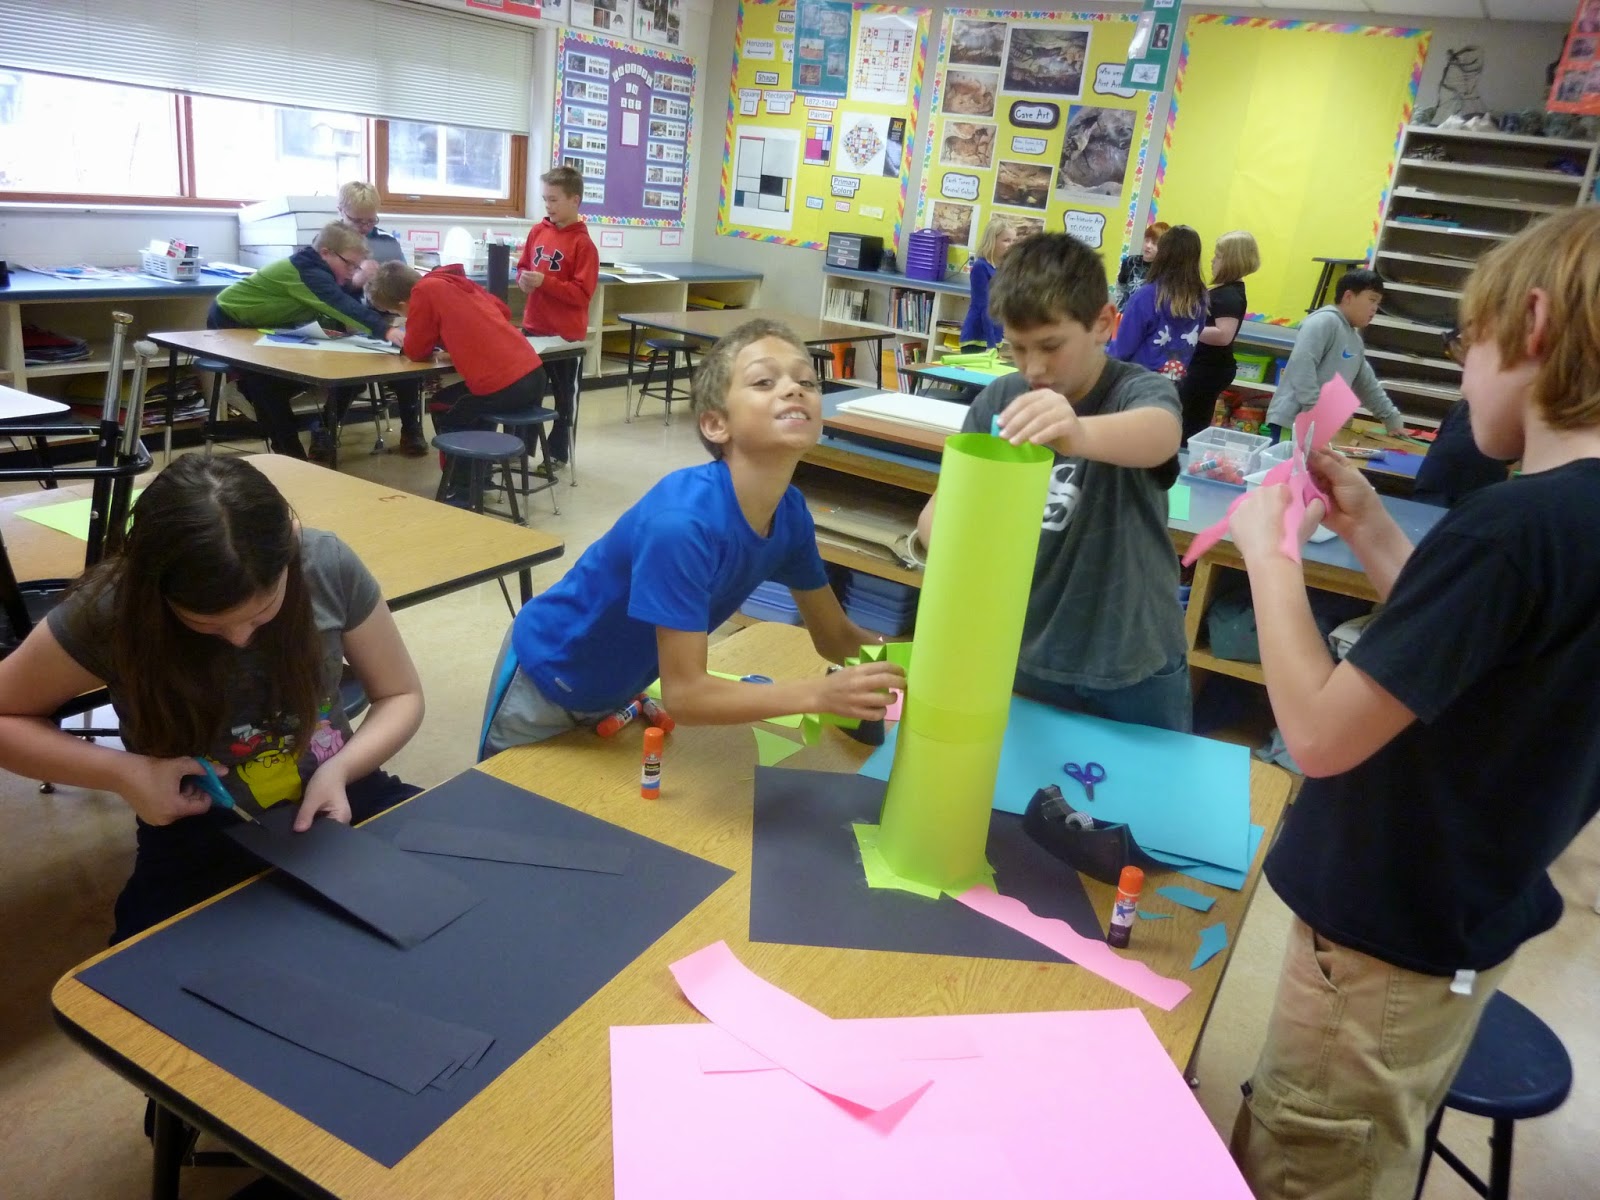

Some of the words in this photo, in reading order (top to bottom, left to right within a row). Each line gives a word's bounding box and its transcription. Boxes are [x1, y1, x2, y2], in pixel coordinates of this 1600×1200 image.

[781, 12, 794, 20] Line
[746, 39, 774, 48] Horizontal
[758, 74, 777, 83] Shape
[740, 90, 760, 98] Square
[765, 91, 793, 100] Rectangle
[806, 98, 836, 107] 1872-1944
[810, 111, 831, 119] Painter
[1016, 109, 1033, 119] Cave
[1036, 109, 1050, 119] Art
[833, 178, 858, 188] Primary
[832, 187, 853, 195] Colors
[808, 199, 821, 207] Blue
[1094, 217, 1103, 225] Art
